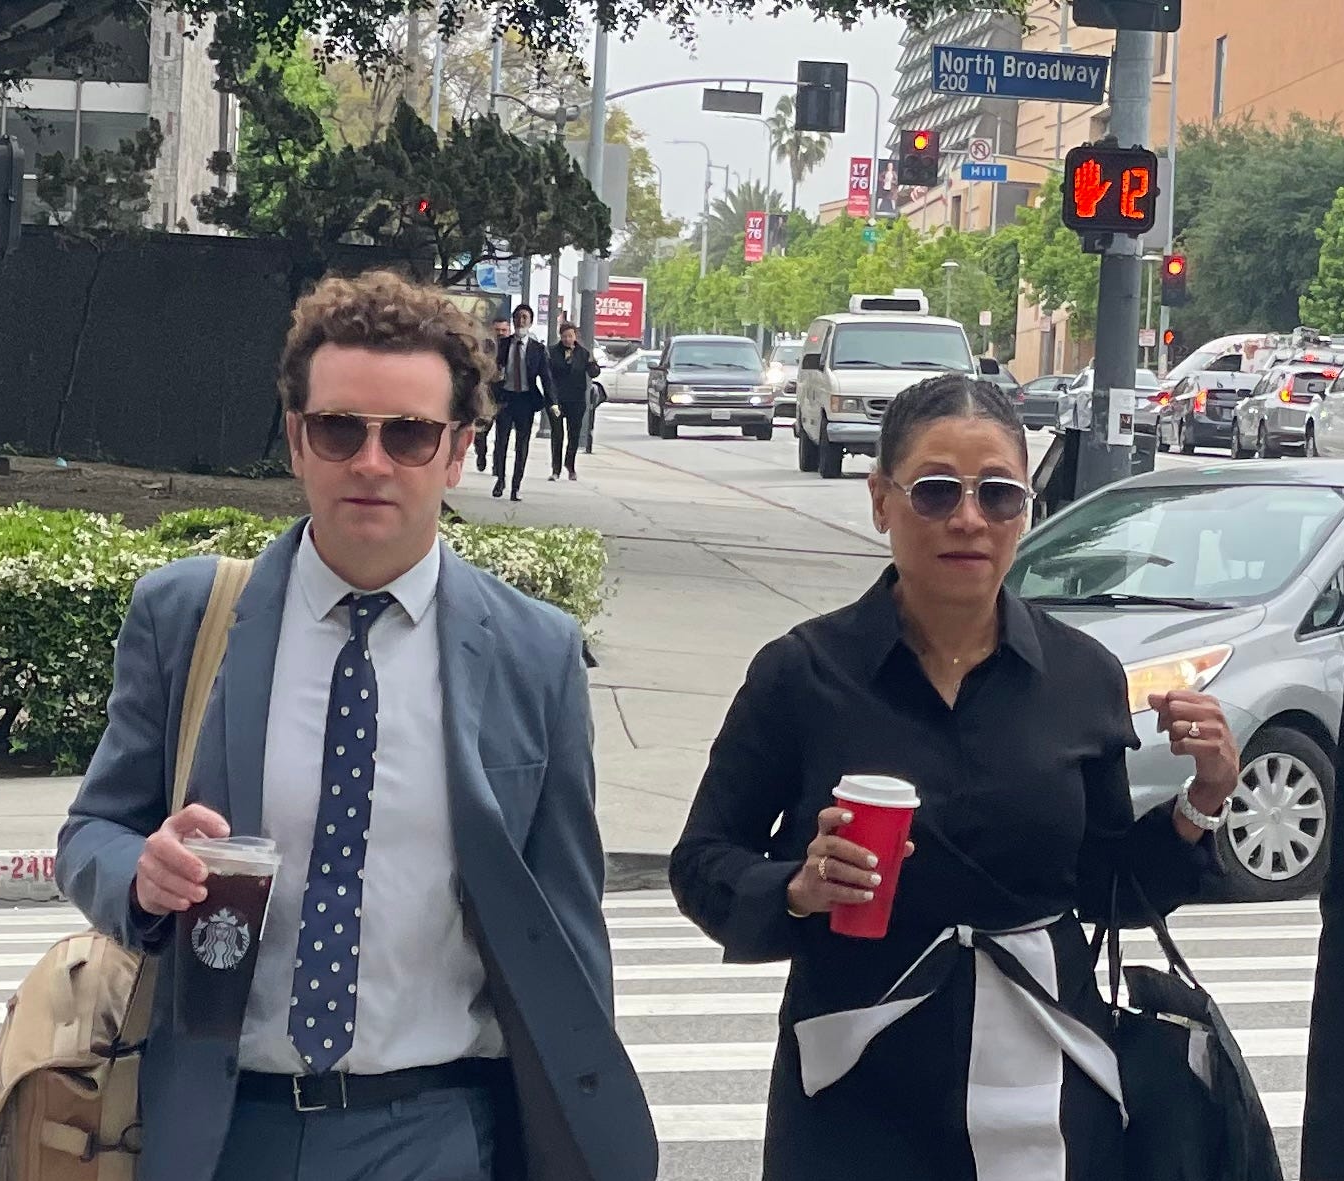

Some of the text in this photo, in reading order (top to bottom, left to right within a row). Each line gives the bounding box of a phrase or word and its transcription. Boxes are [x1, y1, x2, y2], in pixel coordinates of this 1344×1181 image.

[938, 50, 1101, 89] North Broadway
[938, 73, 997, 93] 200 N
[852, 163, 869, 176] 17
[970, 166, 997, 177] Hill
[850, 176, 869, 190] 76
